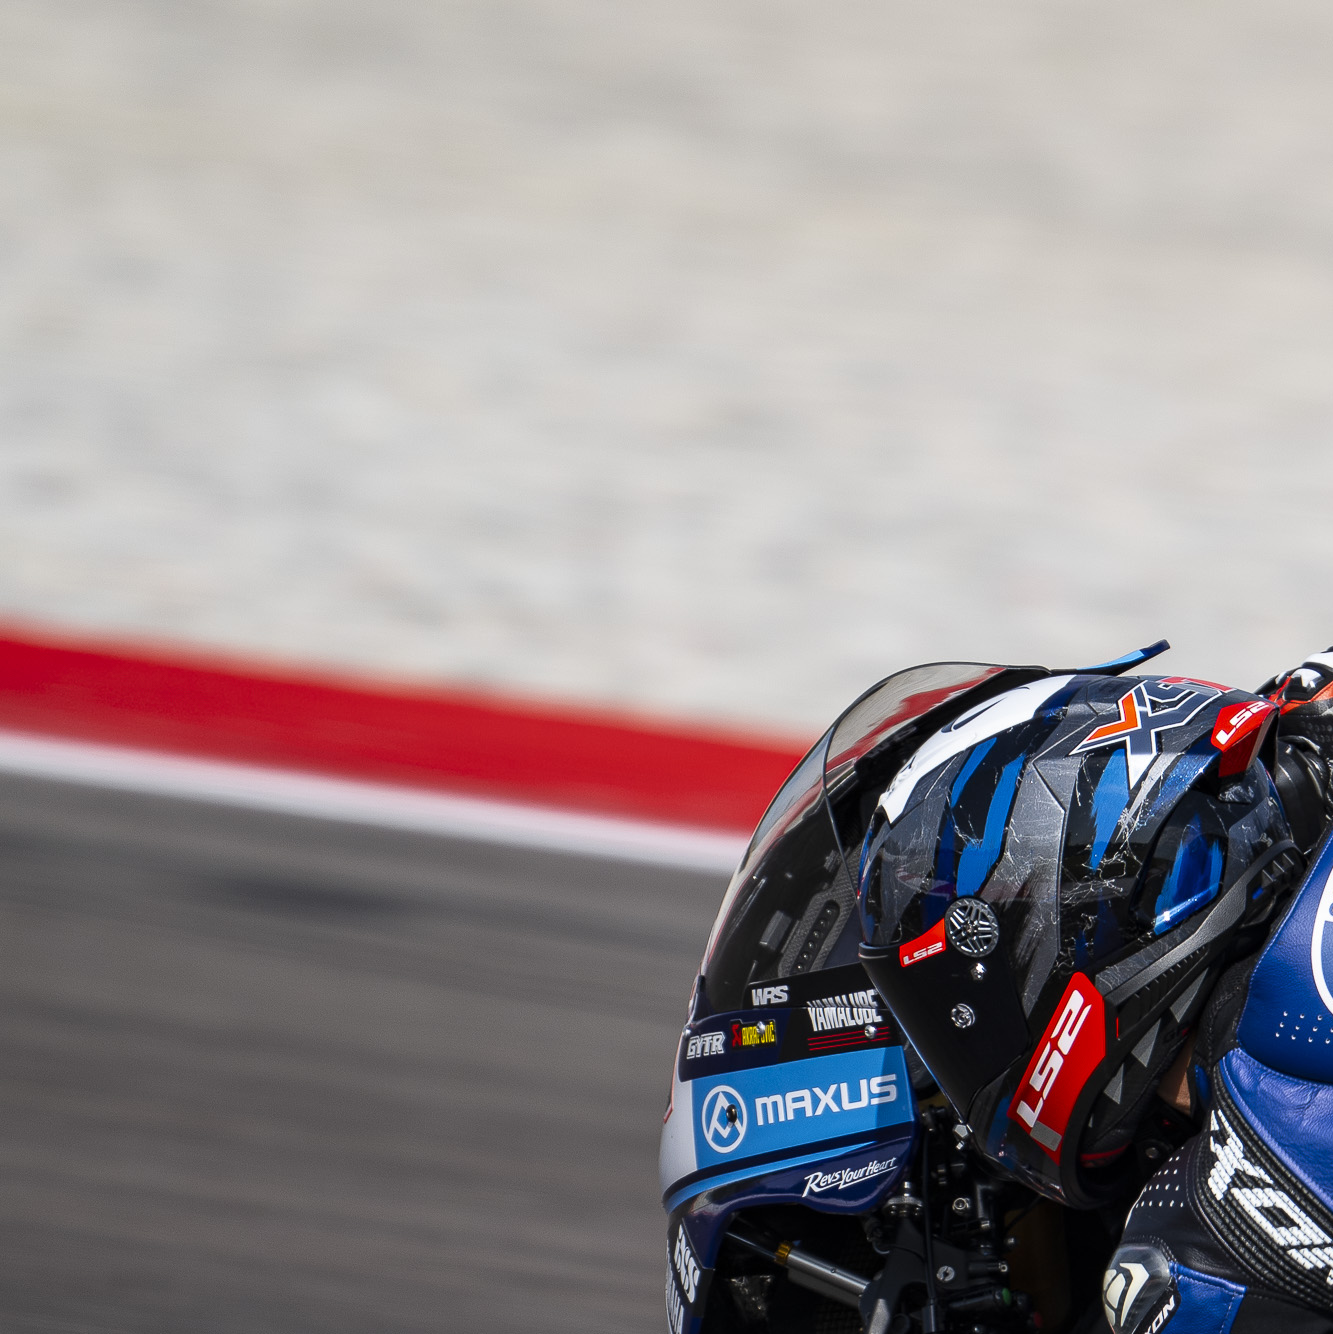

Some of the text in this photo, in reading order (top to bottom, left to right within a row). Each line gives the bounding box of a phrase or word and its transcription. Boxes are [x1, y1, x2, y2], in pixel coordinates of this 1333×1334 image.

[1215, 700, 1269, 746] LS2
[902, 940, 945, 965] LS2
[751, 985, 789, 1006] WRS
[806, 989, 883, 1032] YAMALUBE
[686, 1031, 726, 1059] GYTR
[1017, 988, 1093, 1128] LS2
[755, 1074, 898, 1126] MAXUS
